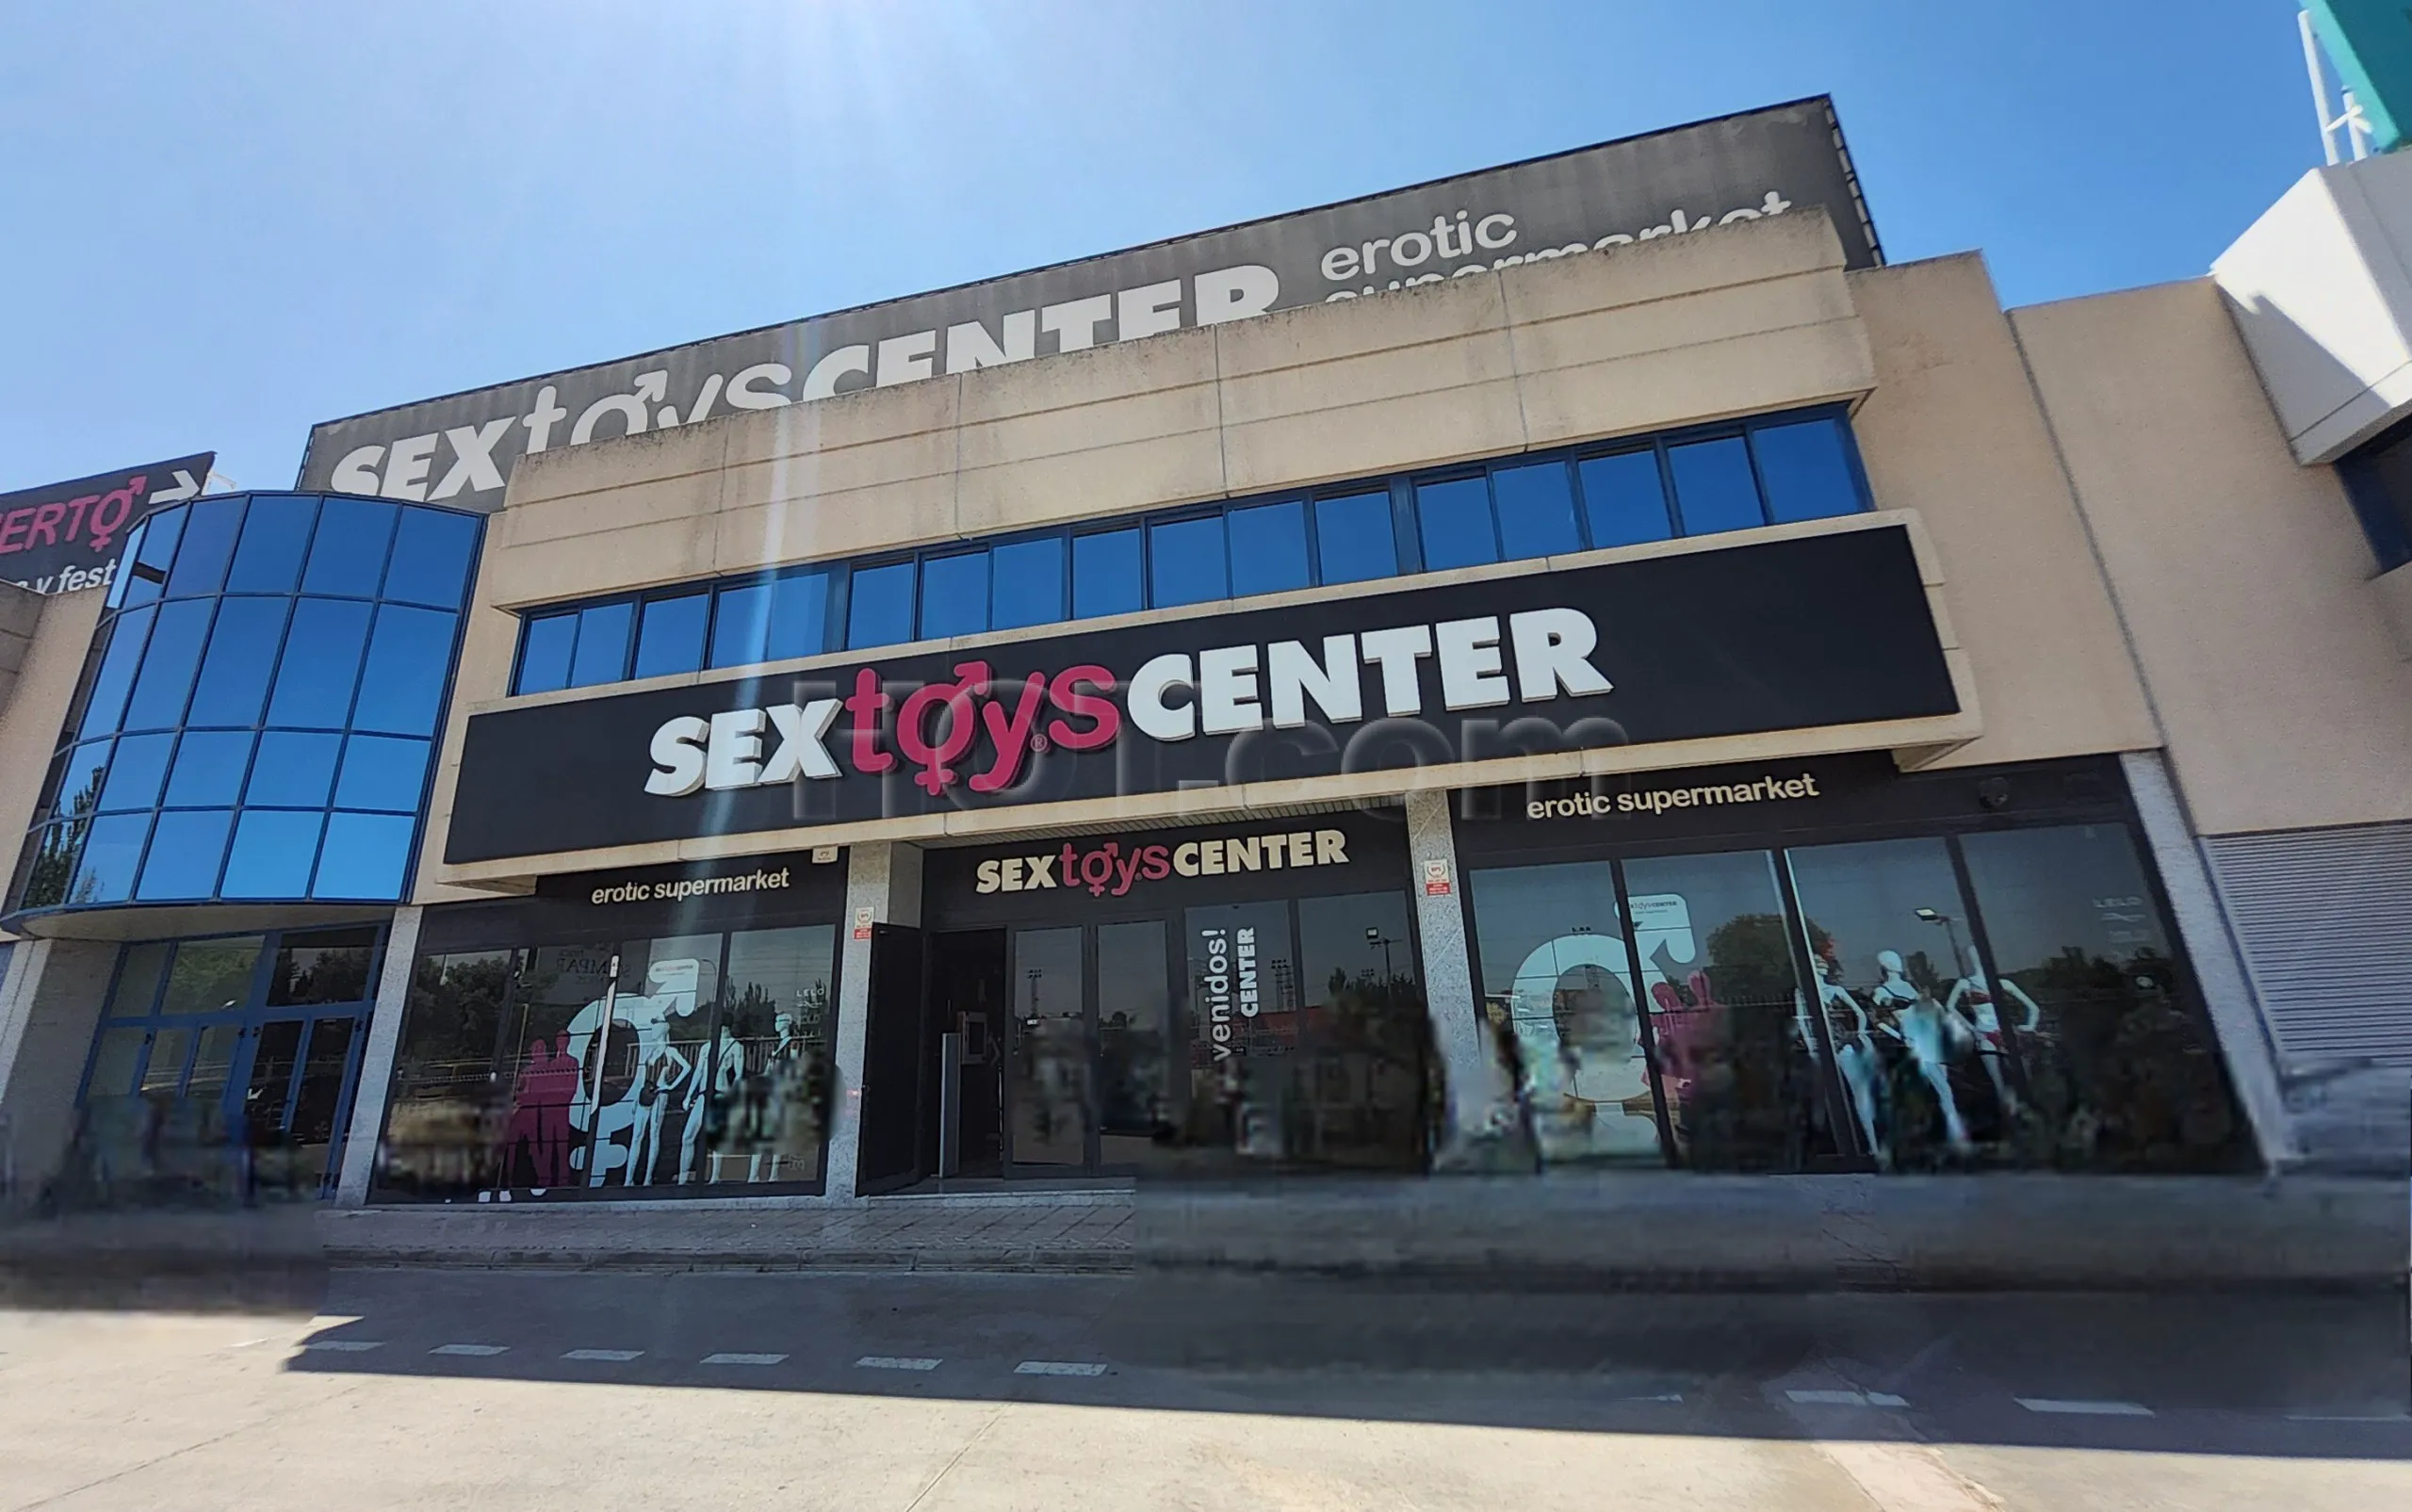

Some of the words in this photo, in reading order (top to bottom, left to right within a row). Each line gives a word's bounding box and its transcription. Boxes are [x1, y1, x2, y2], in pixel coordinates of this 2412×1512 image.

[1321, 210, 1518, 281] erotic
[0, 475, 147, 553] ERTO
[1526, 789, 1610, 819] erotic
[1617, 772, 1820, 815] supermarket
[592, 881, 650, 904] erotic
[654, 867, 790, 902] supermarket
[1201, 929, 1231, 1061] venidos!
[1237, 927, 1259, 1017] CENTER
